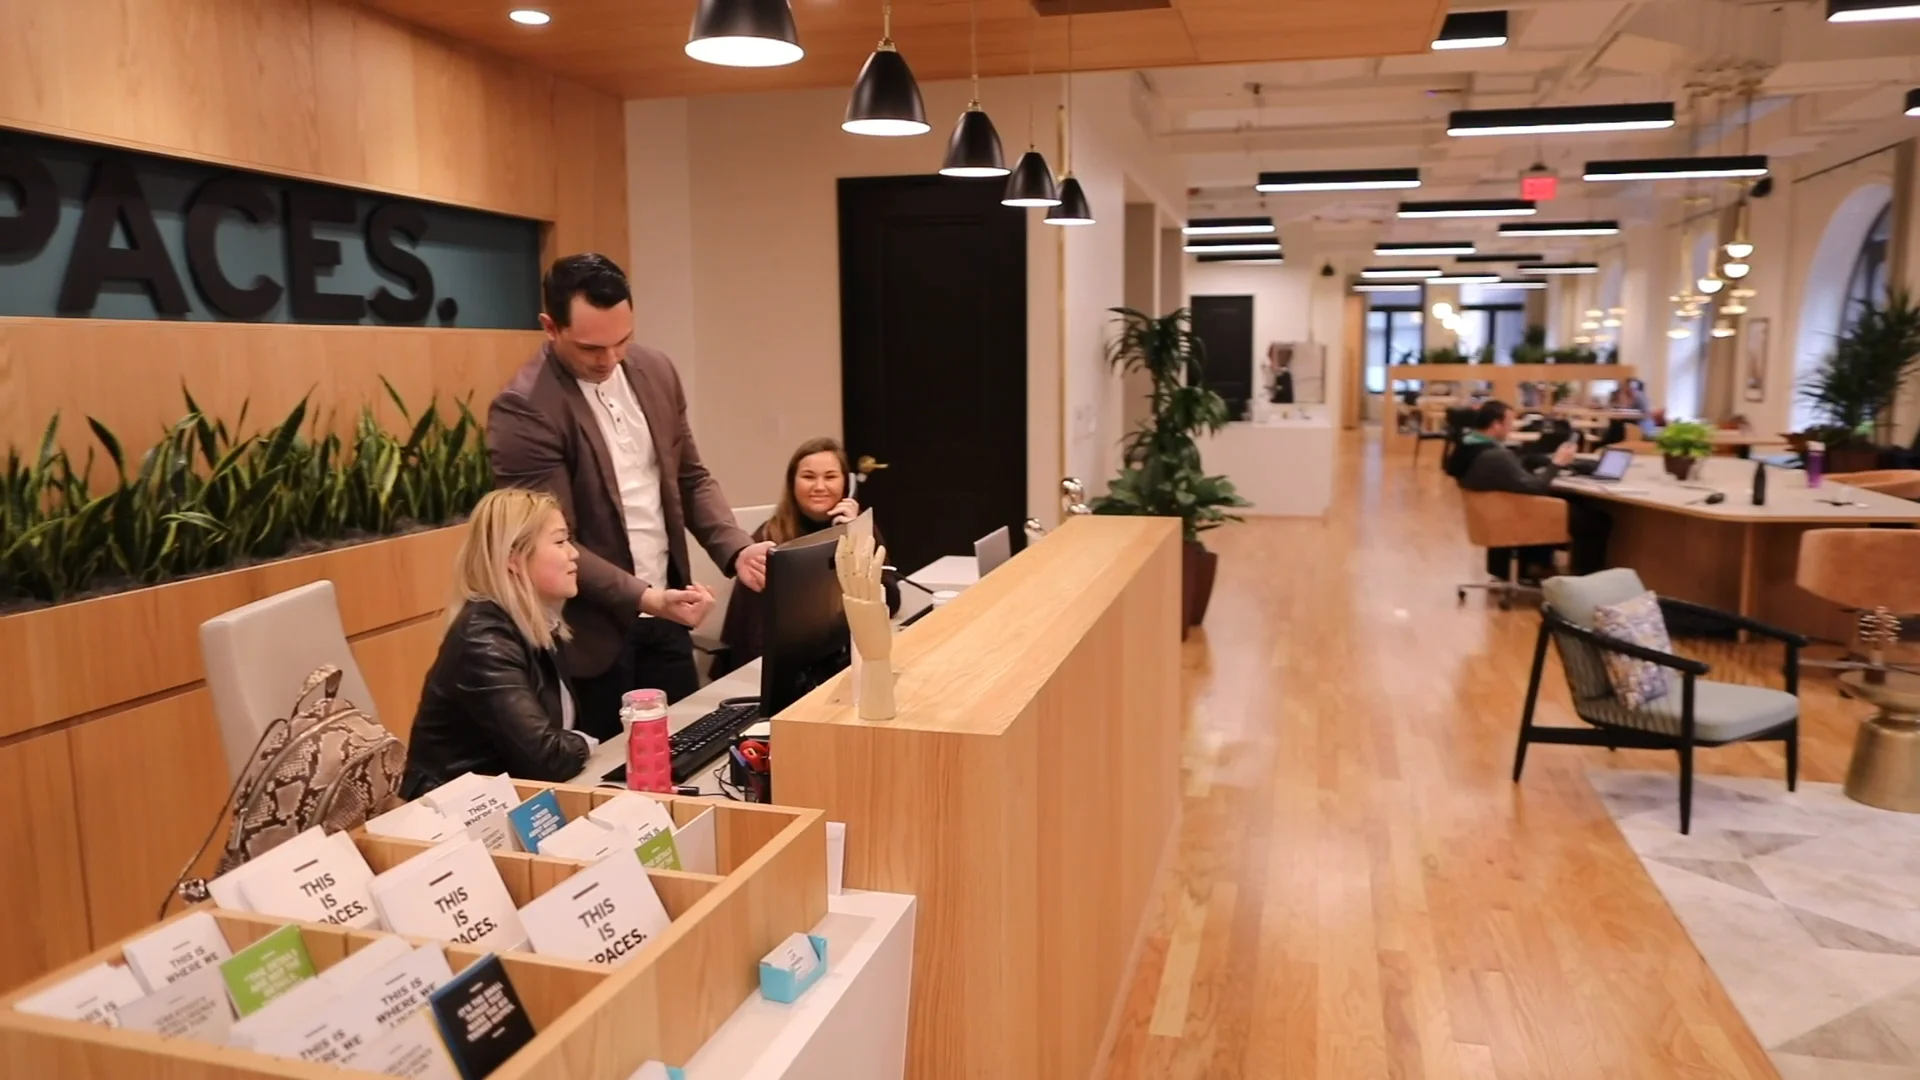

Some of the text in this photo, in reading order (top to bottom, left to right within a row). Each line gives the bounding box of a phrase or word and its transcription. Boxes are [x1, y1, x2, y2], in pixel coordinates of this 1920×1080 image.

[300, 872, 336, 897] THIS
[319, 893, 338, 910] IS
[434, 886, 469, 914] THIS
[578, 897, 616, 928] THIS
[452, 908, 469, 928] IS
[598, 921, 616, 942] IS
[169, 945, 206, 969] THIS IS
[588, 928, 648, 964] PACES.
[165, 951, 220, 985] WHERE WE
[380, 976, 423, 1006] THIS IS
[376, 994, 418, 1025] WHERE
[299, 1037, 331, 1061] THIS
[331, 1028, 346, 1043] IS
[343, 1033, 363, 1051] WE
